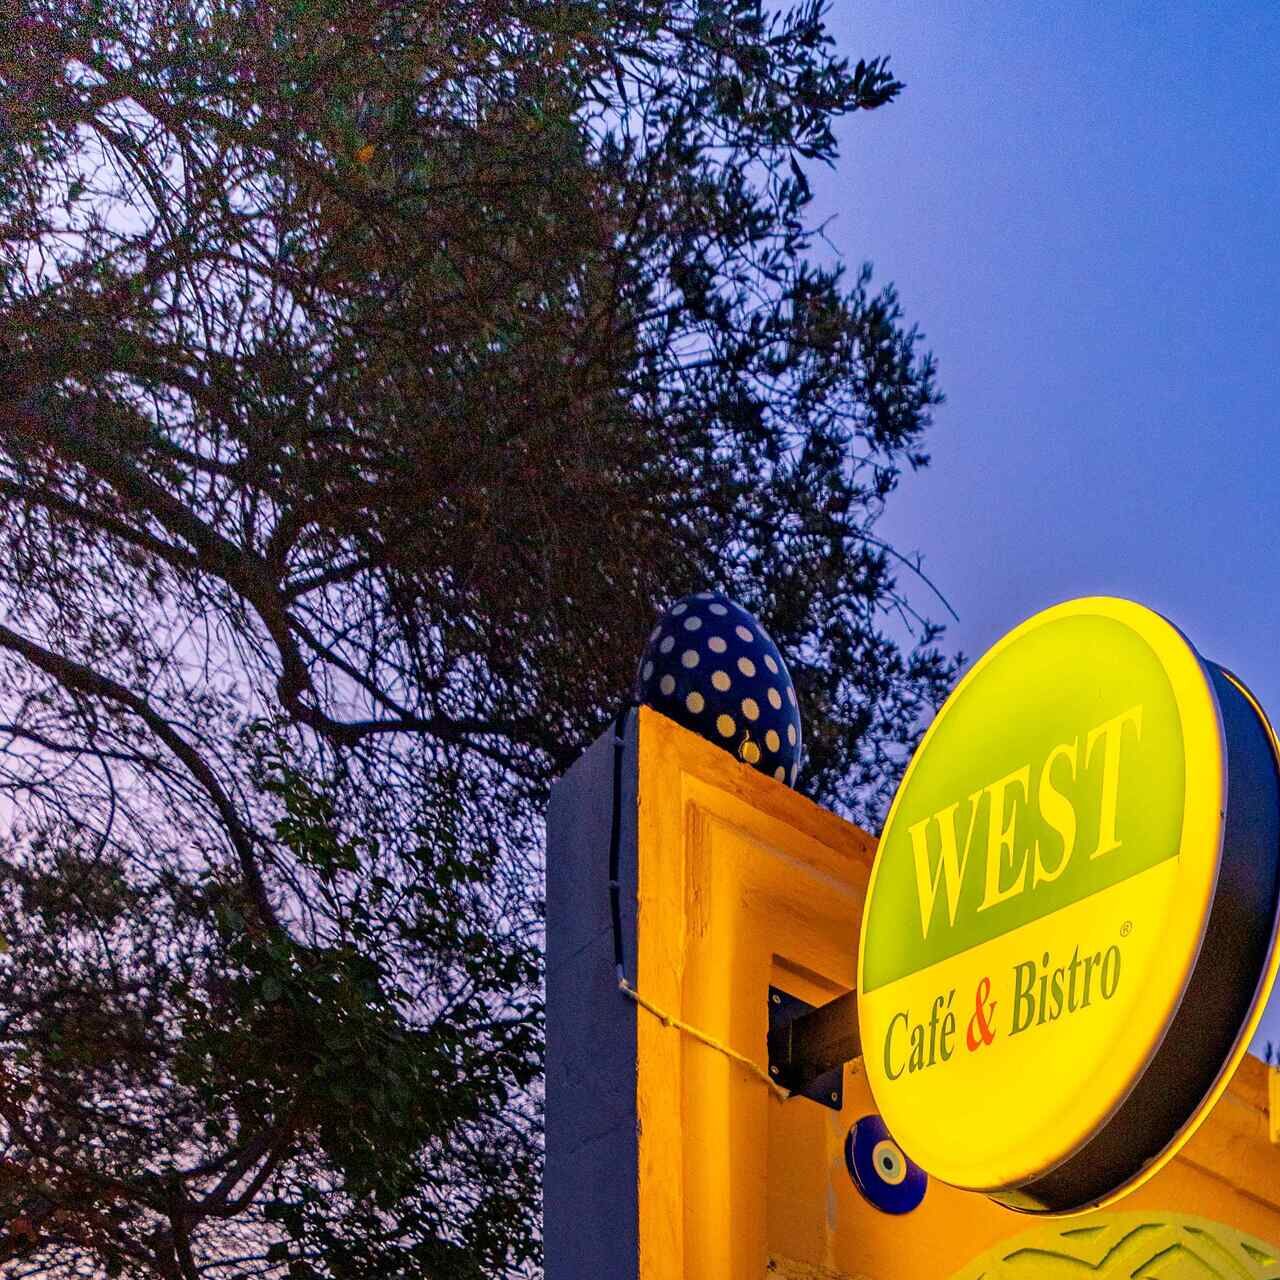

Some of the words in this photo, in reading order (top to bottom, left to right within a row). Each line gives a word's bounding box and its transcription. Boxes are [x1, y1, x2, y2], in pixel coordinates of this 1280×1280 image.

[908, 703, 1143, 940] WEST
[883, 988, 957, 1081] Café
[966, 976, 998, 1052] &
[1008, 943, 1121, 1037] Bistro
